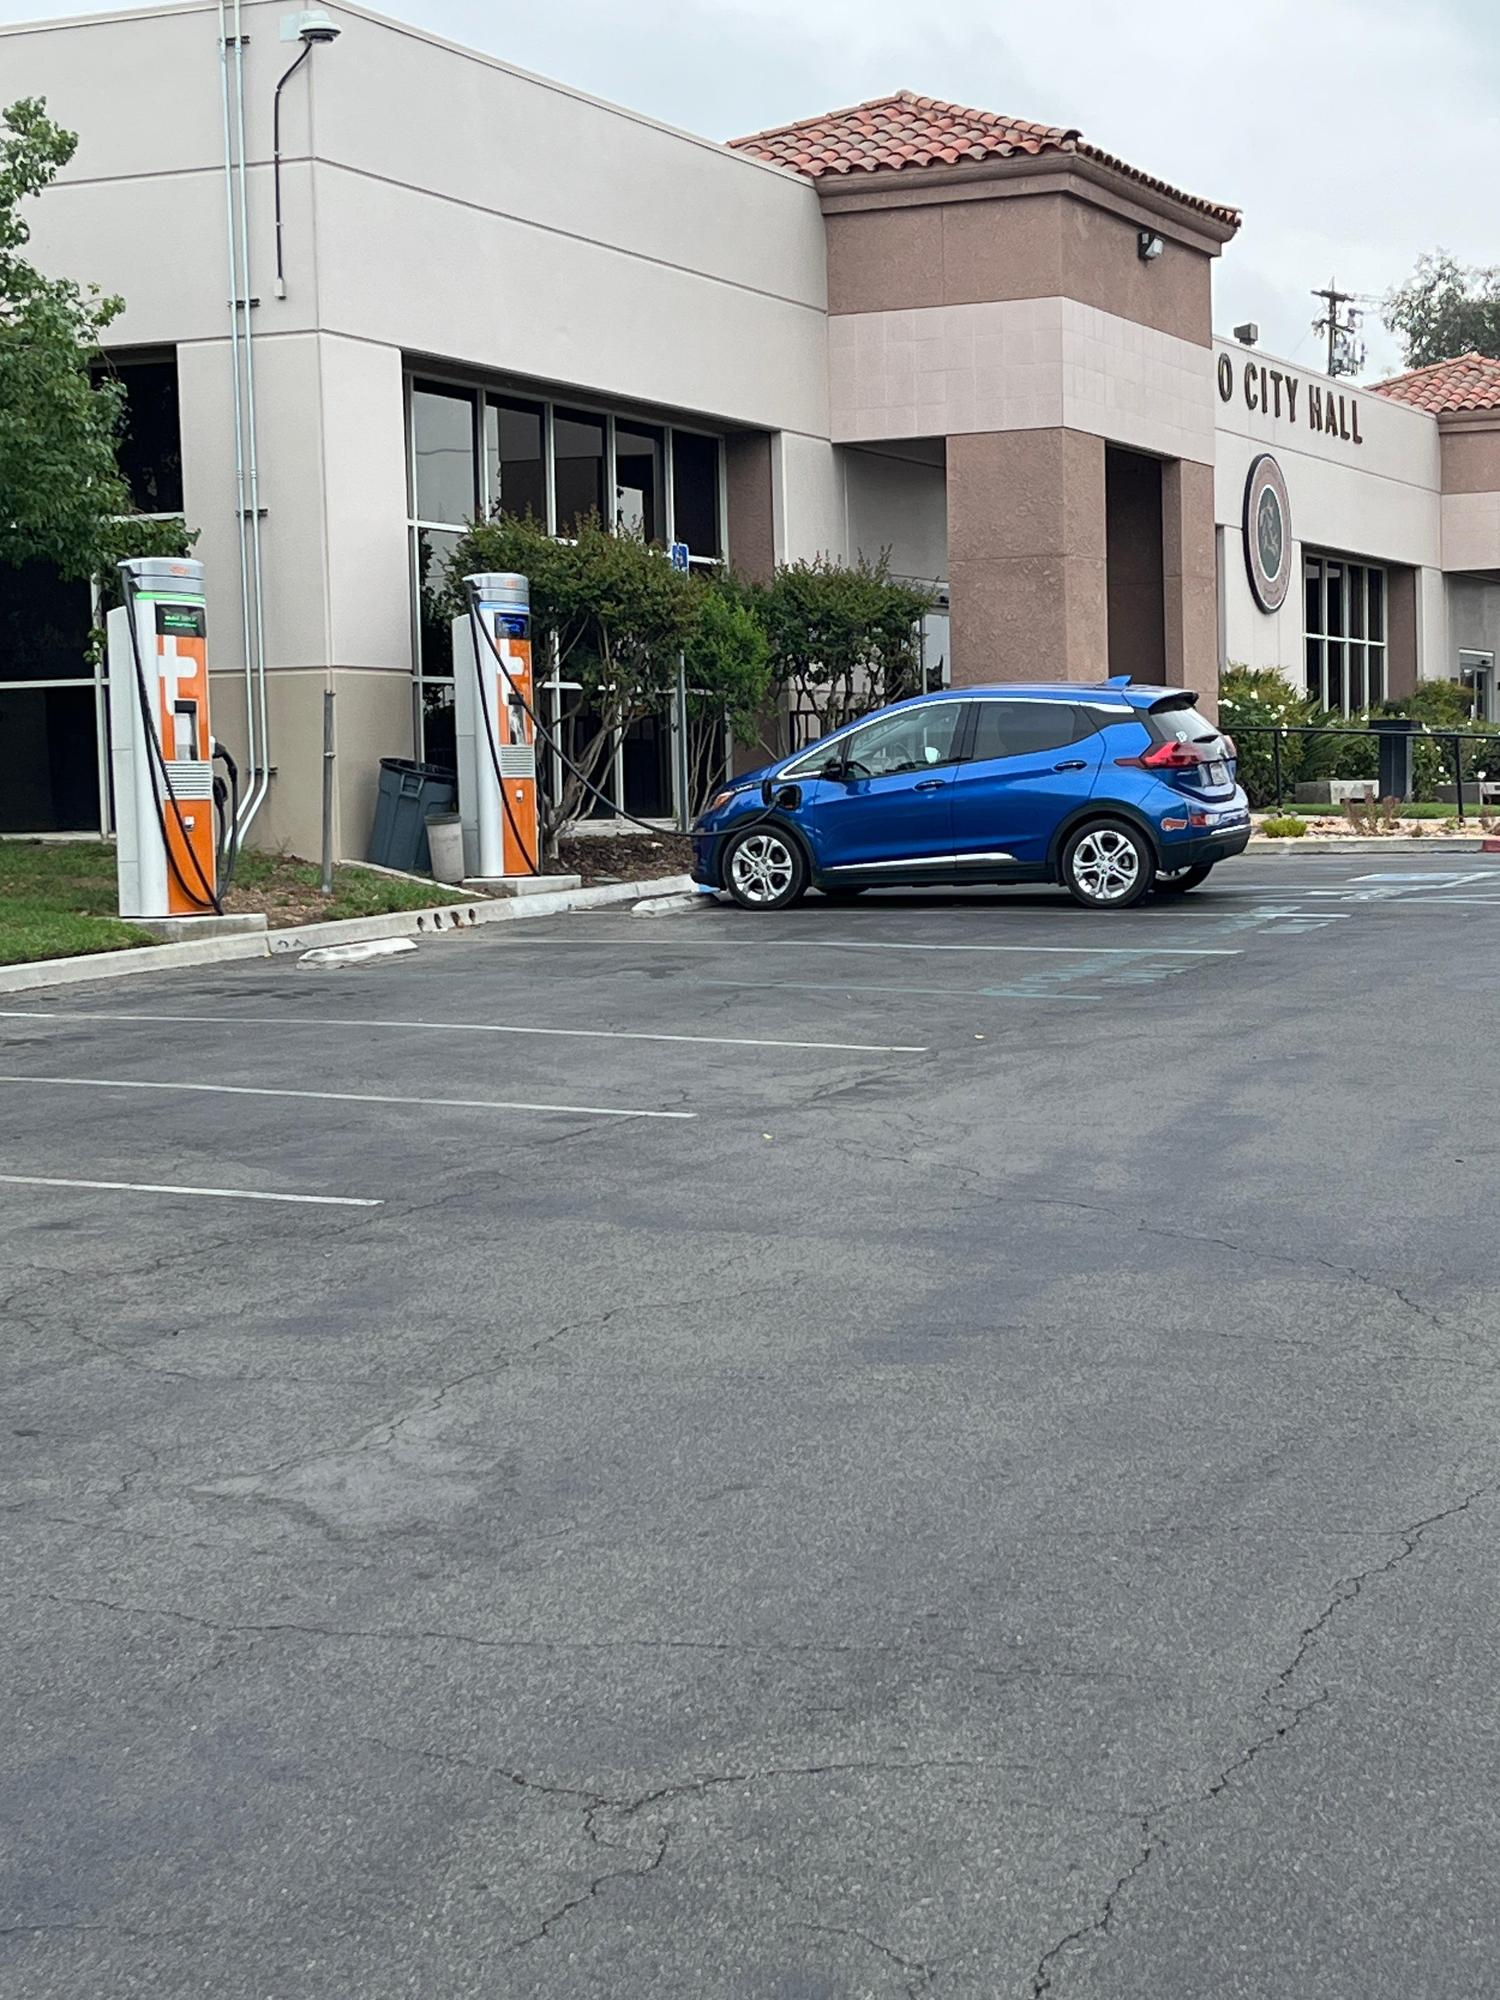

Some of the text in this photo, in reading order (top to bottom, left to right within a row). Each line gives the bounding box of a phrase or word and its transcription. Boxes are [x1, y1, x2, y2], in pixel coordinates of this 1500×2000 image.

[1217, 352, 1363, 444] O CITY HALL
